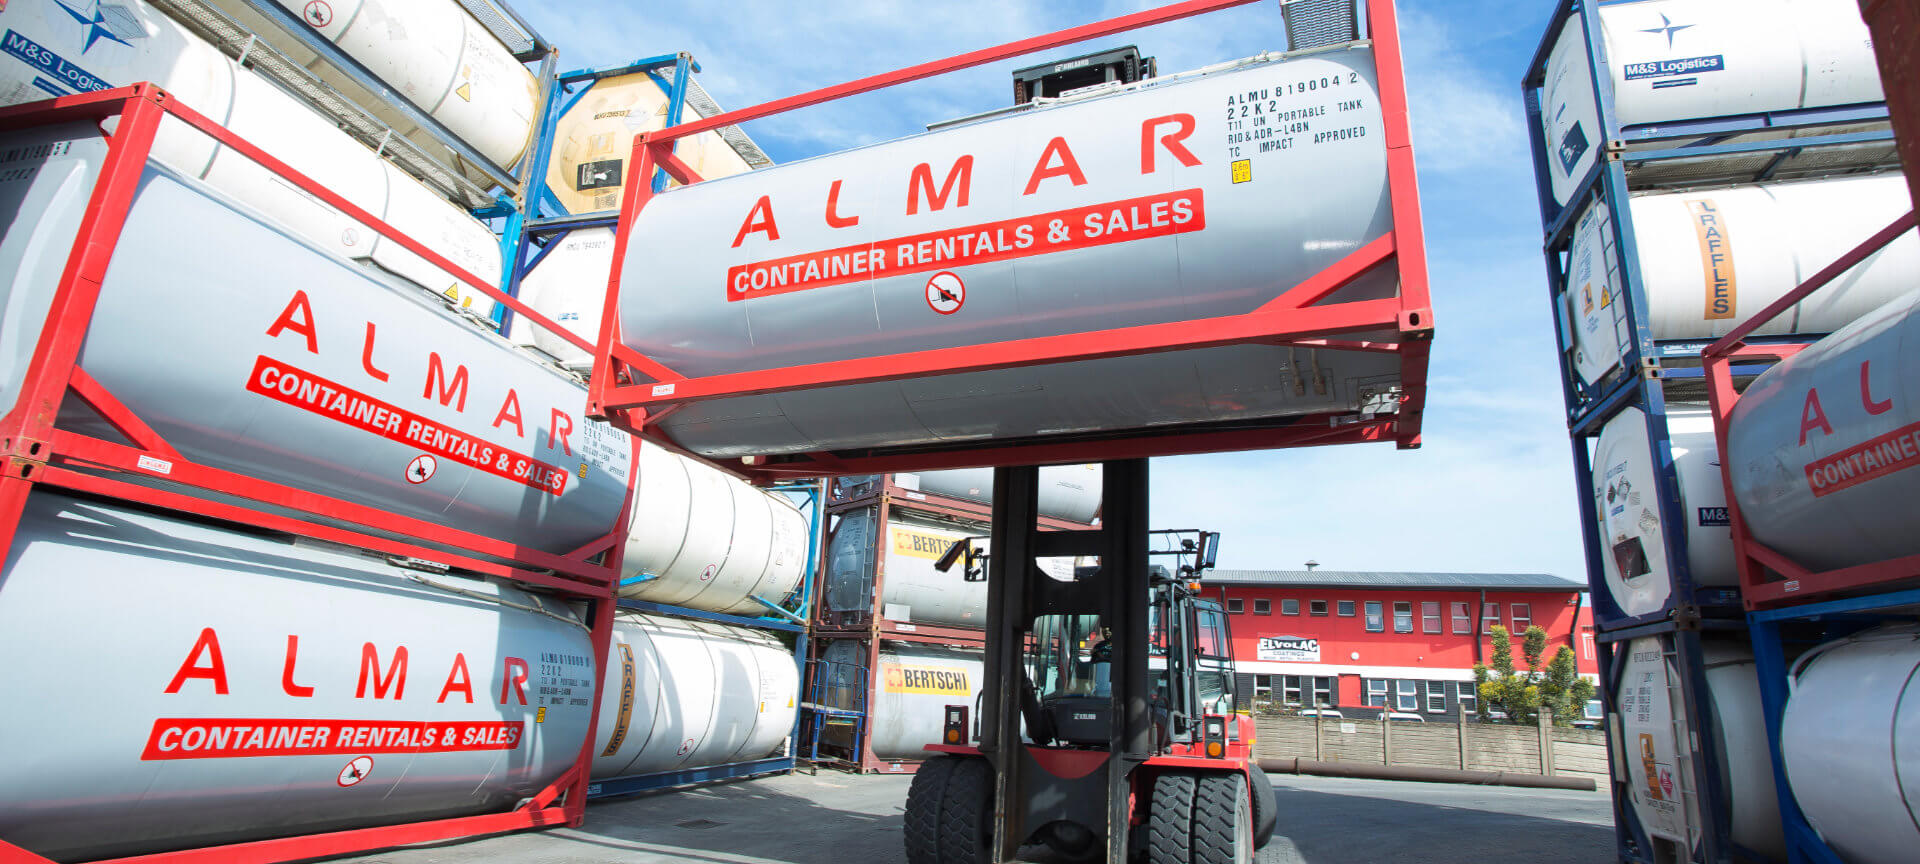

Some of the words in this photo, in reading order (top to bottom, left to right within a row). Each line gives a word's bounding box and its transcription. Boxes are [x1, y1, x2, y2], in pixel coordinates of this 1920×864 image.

[8, 34, 54, 66] M&S
[57, 60, 110, 92] Logis
[1626, 63, 1657, 75] M&S
[1660, 58, 1718, 73] Logistics
[1228, 89, 1268, 106] ALMU
[1275, 75, 1340, 97] 819004
[1349, 72, 1358, 84] 2
[1228, 100, 1277, 120] 22K2
[1254, 116, 1266, 127] UN
[1278, 106, 1326, 122] PORTABLE
[1337, 99, 1363, 112] TANK
[1229, 147, 1241, 158] TC
[1260, 138, 1294, 153] IMPACT
[1314, 126, 1366, 144] APPROVED
[731, 113, 1202, 248] ALMAR
[734, 249, 886, 294] CONTAINER
[897, 224, 1034, 267] RENTALS
[1047, 219, 1071, 243] &
[1084, 198, 1193, 238] SALES
[266, 290, 573, 456] ALMAR
[260, 367, 402, 434] CONTAINER
[406, 420, 492, 465] RENTALS
[496, 453, 510, 472] &
[514, 460, 564, 490] SALES
[164, 628, 528, 705] ALMAR
[903, 669, 967, 690] BERTSCHI
[159, 727, 330, 752] CONTAINER
[336, 727, 437, 747] RENTALS
[442, 728, 457, 746] &
[462, 727, 518, 746] SALES
